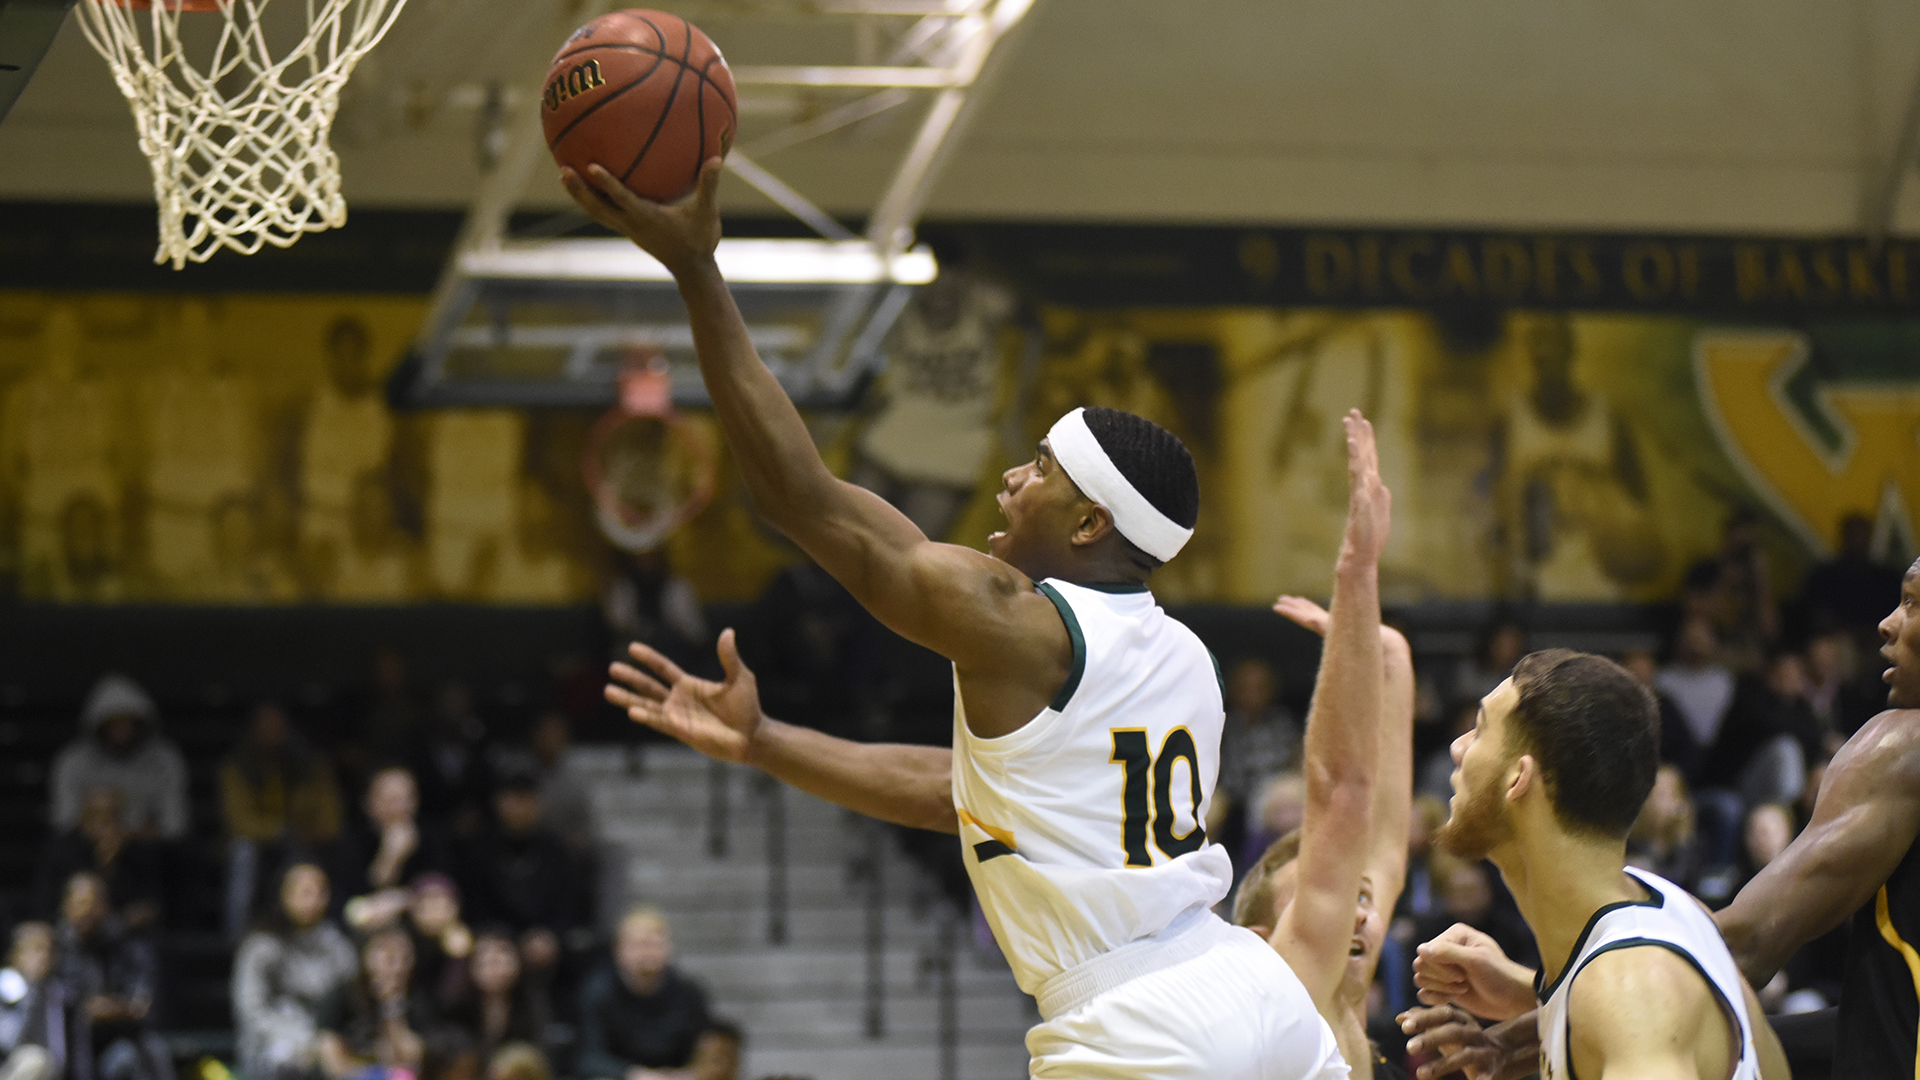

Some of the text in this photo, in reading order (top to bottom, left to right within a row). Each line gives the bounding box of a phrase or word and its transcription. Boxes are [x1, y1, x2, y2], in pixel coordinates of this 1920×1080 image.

[1304, 238, 1601, 298] DECADES
[1622, 240, 1703, 298] OF
[1108, 725, 1206, 869] 10
